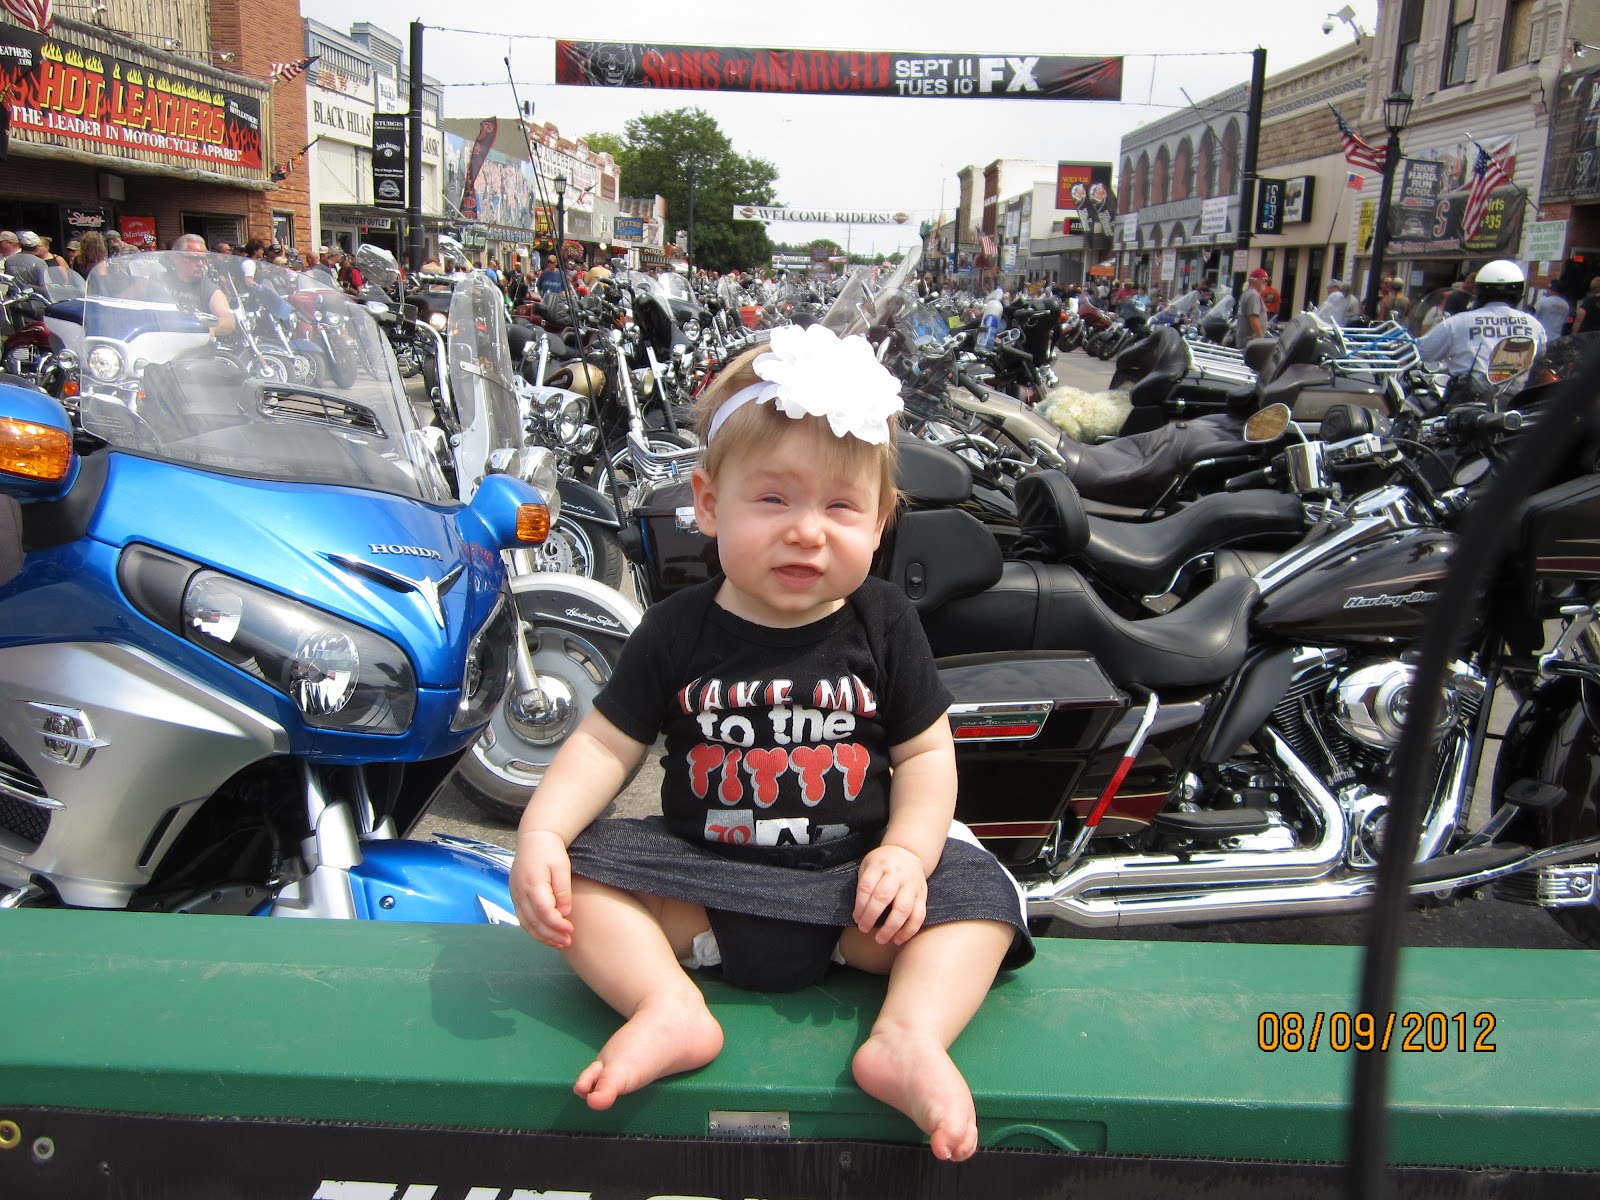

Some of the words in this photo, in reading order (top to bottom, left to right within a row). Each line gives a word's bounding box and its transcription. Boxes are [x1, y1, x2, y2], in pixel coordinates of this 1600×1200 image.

[0, 46, 33, 58] EATHERS
[641, 50, 720, 90] SONS
[724, 58, 750, 86] OF
[750, 49, 892, 92] ANARCHY
[895, 58, 953, 78] SEPT
[958, 58, 972, 75] 11
[978, 57, 1040, 93] FX
[895, 79, 948, 96] TUES
[40, 59, 106, 119] HOT
[111, 79, 225, 145] LEATHERS
[12, 105, 44, 127] THE
[48, 112, 101, 137] LEADER
[105, 124, 119, 141] IN
[123, 127, 200, 155] MOTORCYCLE
[313, 100, 345, 130] BLACK
[346, 110, 371, 137] HILLS
[422, 135, 441, 158] LASSIC
[1413, 163, 1437, 172] RIDE
[1407, 171, 1437, 182] HARD.
[1411, 180, 1433, 188] RUN
[1405, 187, 1436, 198] COOL.
[341, 216, 366, 225] FACTORY
[366, 217, 389, 227] OUTLET
[758, 208, 831, 222] WELCOME
[836, 212, 890, 224] RIDERS!
[1485, 214, 1502, 229] $35
[615, 219, 641, 230] TATTOO
[1475, 316, 1528, 326] STURGIS
[1468, 326, 1533, 340] POLICE
[368, 543, 444, 562] HONDA
[564, 607, 597, 622] Heritage
[596, 615, 621, 628] Softail
[696, 709, 755, 748] to
[768, 704, 856, 745] the
[686, 742, 871, 809] TITTY
